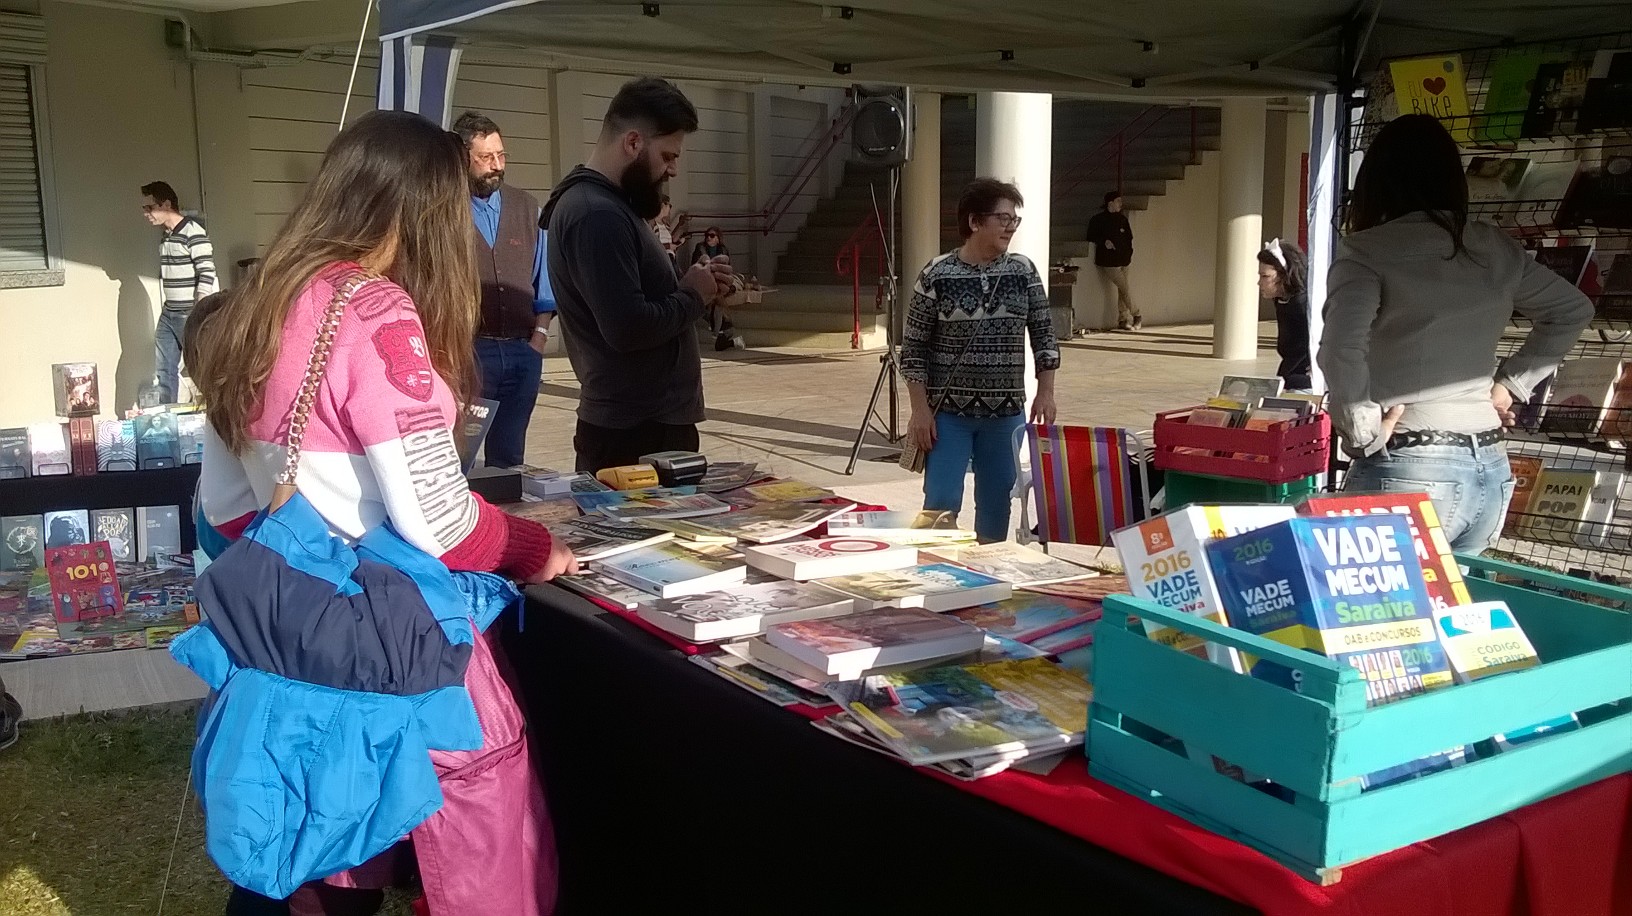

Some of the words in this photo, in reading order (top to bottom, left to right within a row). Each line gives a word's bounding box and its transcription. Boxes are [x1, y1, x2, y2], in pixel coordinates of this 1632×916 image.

[1545, 484, 1582, 495] PAPAI
[1538, 501, 1577, 513] POP
[1234, 538, 1273, 562] 2016
[1312, 525, 1402, 566] VADE
[66, 563, 98, 581] 101
[1141, 550, 1191, 582] 2016
[1146, 569, 1199, 598] VADE
[1240, 579, 1291, 605] VADE
[1325, 564, 1410, 597] MECUM
[1245, 595, 1295, 618] MECUM
[1335, 598, 1416, 623] Saraiva
[1344, 633, 1363, 646] OAB
[1369, 627, 1421, 643] CONCURSOS
[1402, 646, 1433, 667] 2016
[1483, 653, 1528, 668] Saraiva
